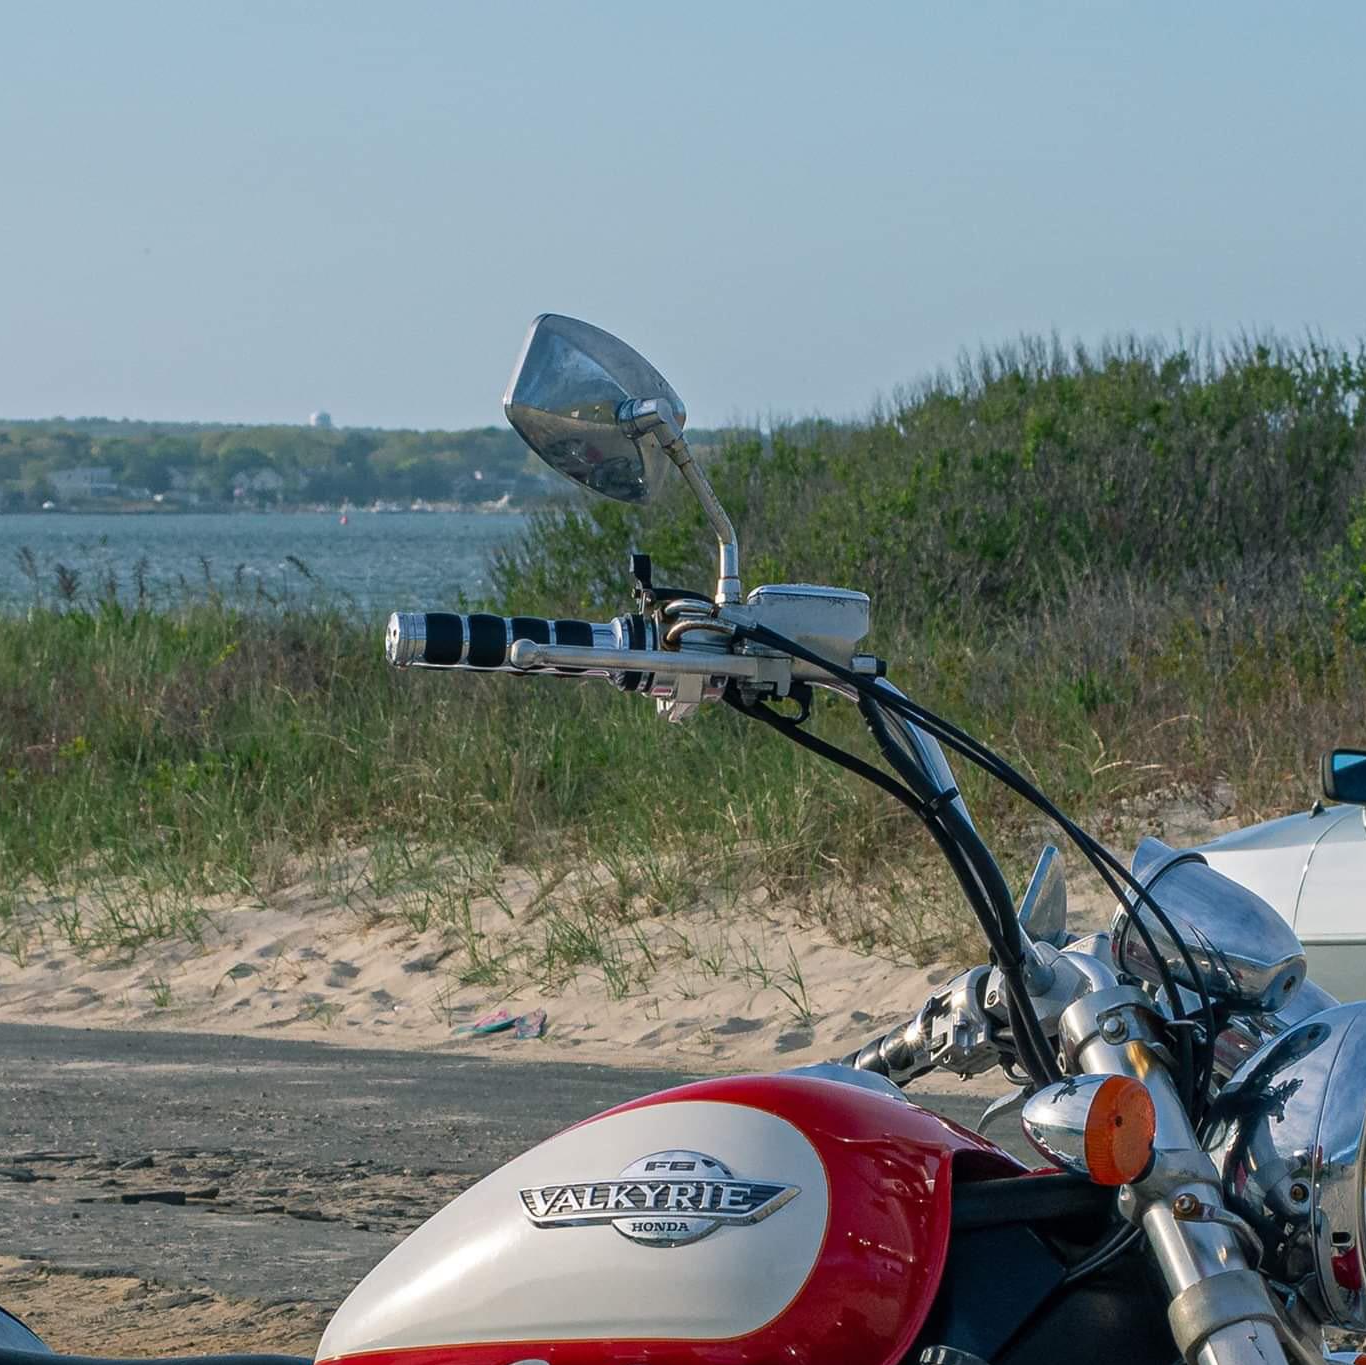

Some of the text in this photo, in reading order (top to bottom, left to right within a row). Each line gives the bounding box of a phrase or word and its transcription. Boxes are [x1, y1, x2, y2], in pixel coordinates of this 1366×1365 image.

[644, 1161, 696, 1172] F6
[530, 1182, 754, 1216] VALKYRIE
[631, 1222, 690, 1233] HONDA
